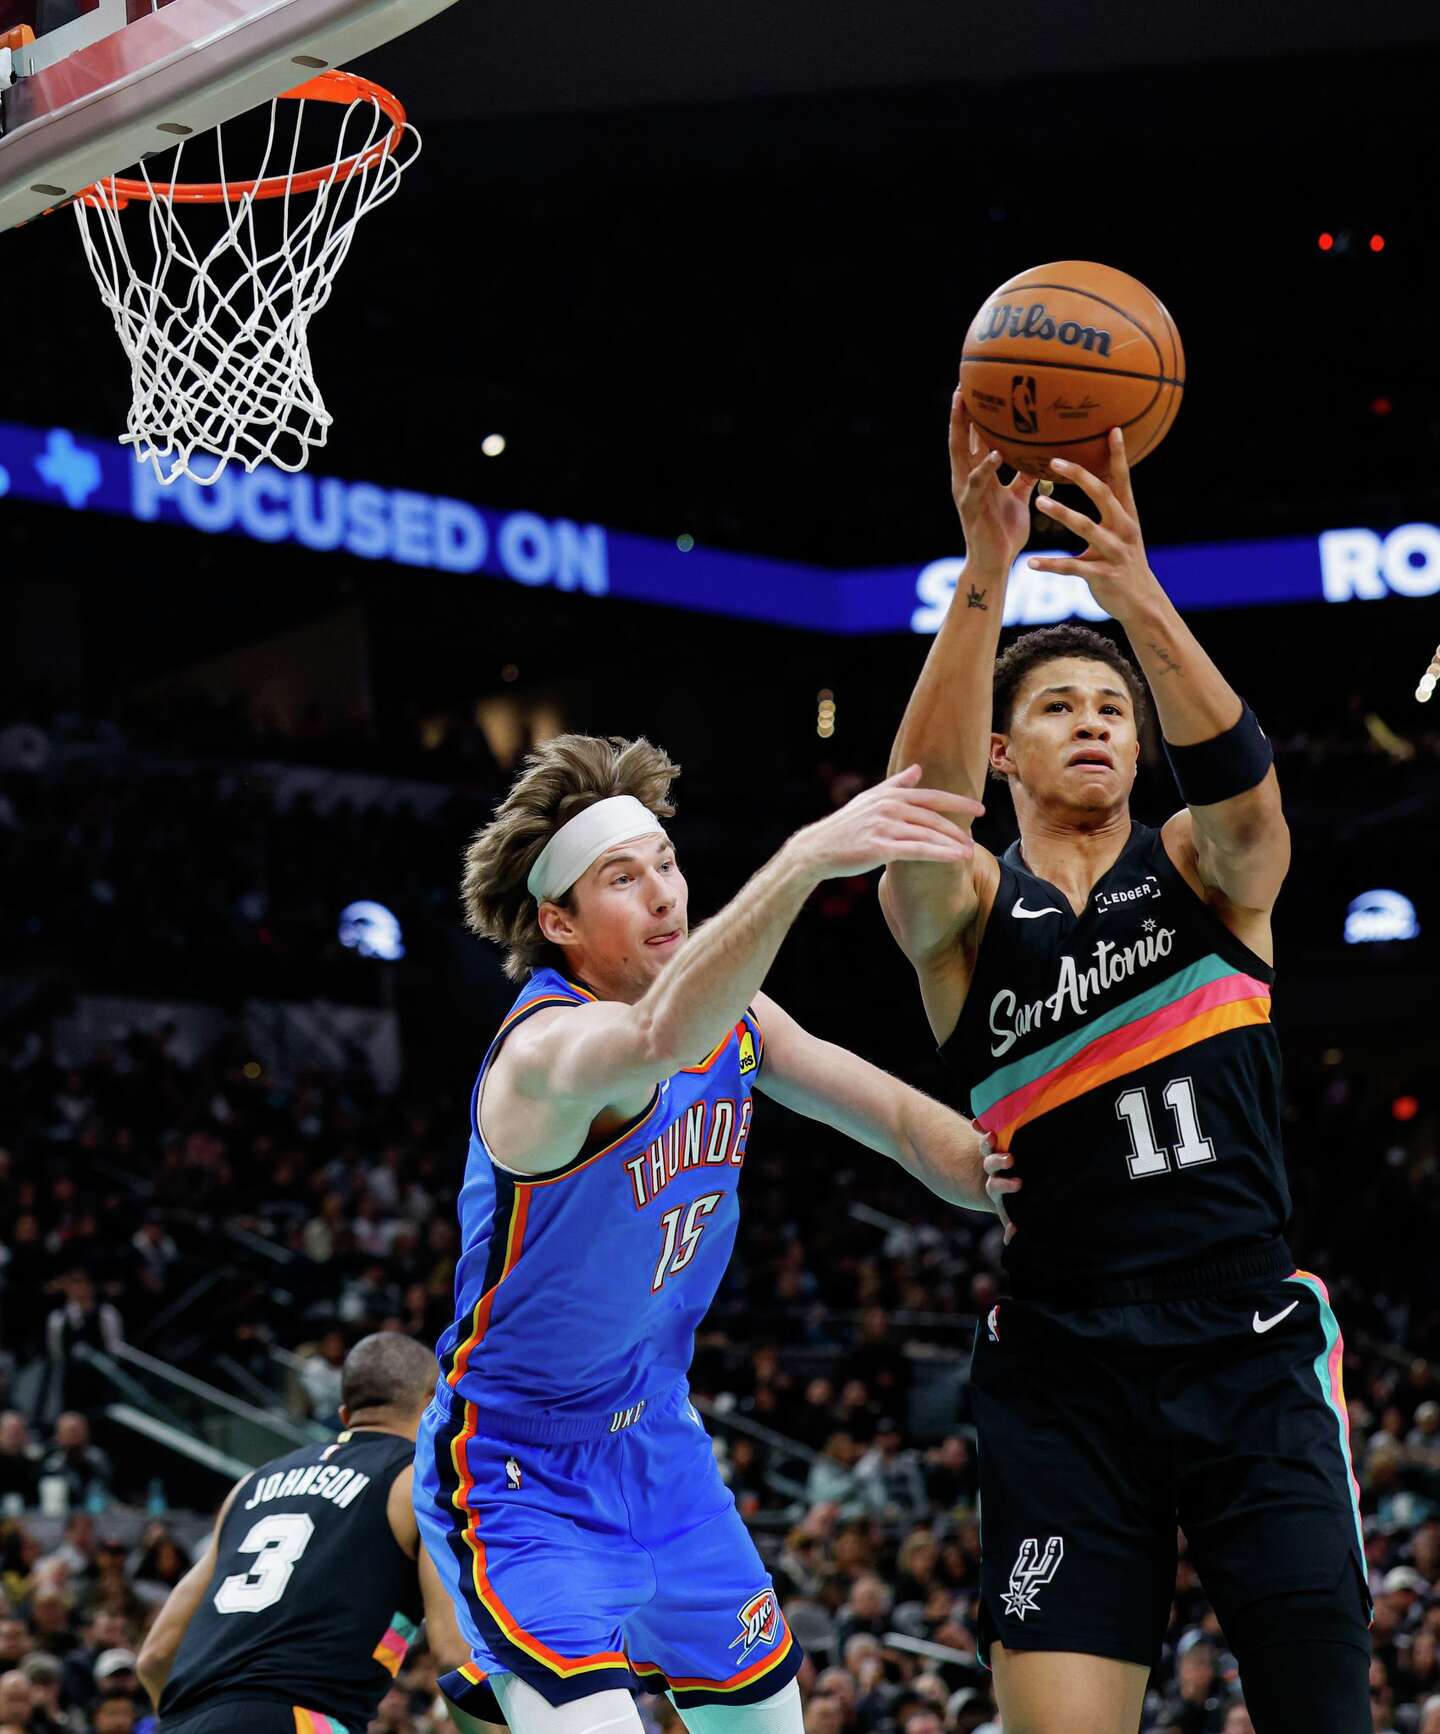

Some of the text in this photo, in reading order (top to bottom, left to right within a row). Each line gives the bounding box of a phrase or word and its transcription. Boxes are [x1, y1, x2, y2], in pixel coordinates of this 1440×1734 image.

[976, 303, 1111, 358] Wilson
[130, 444, 610, 598] FOCUSED ON
[1318, 522, 1440, 603] RO
[1102, 883, 1151, 906] LEDGER
[989, 919, 1176, 1058] San Antonio
[1115, 1076, 1217, 1180] 11
[651, 1190, 725, 1293] 15
[245, 1465, 370, 1510] JOHNSON
[213, 1513, 315, 1614] 3
